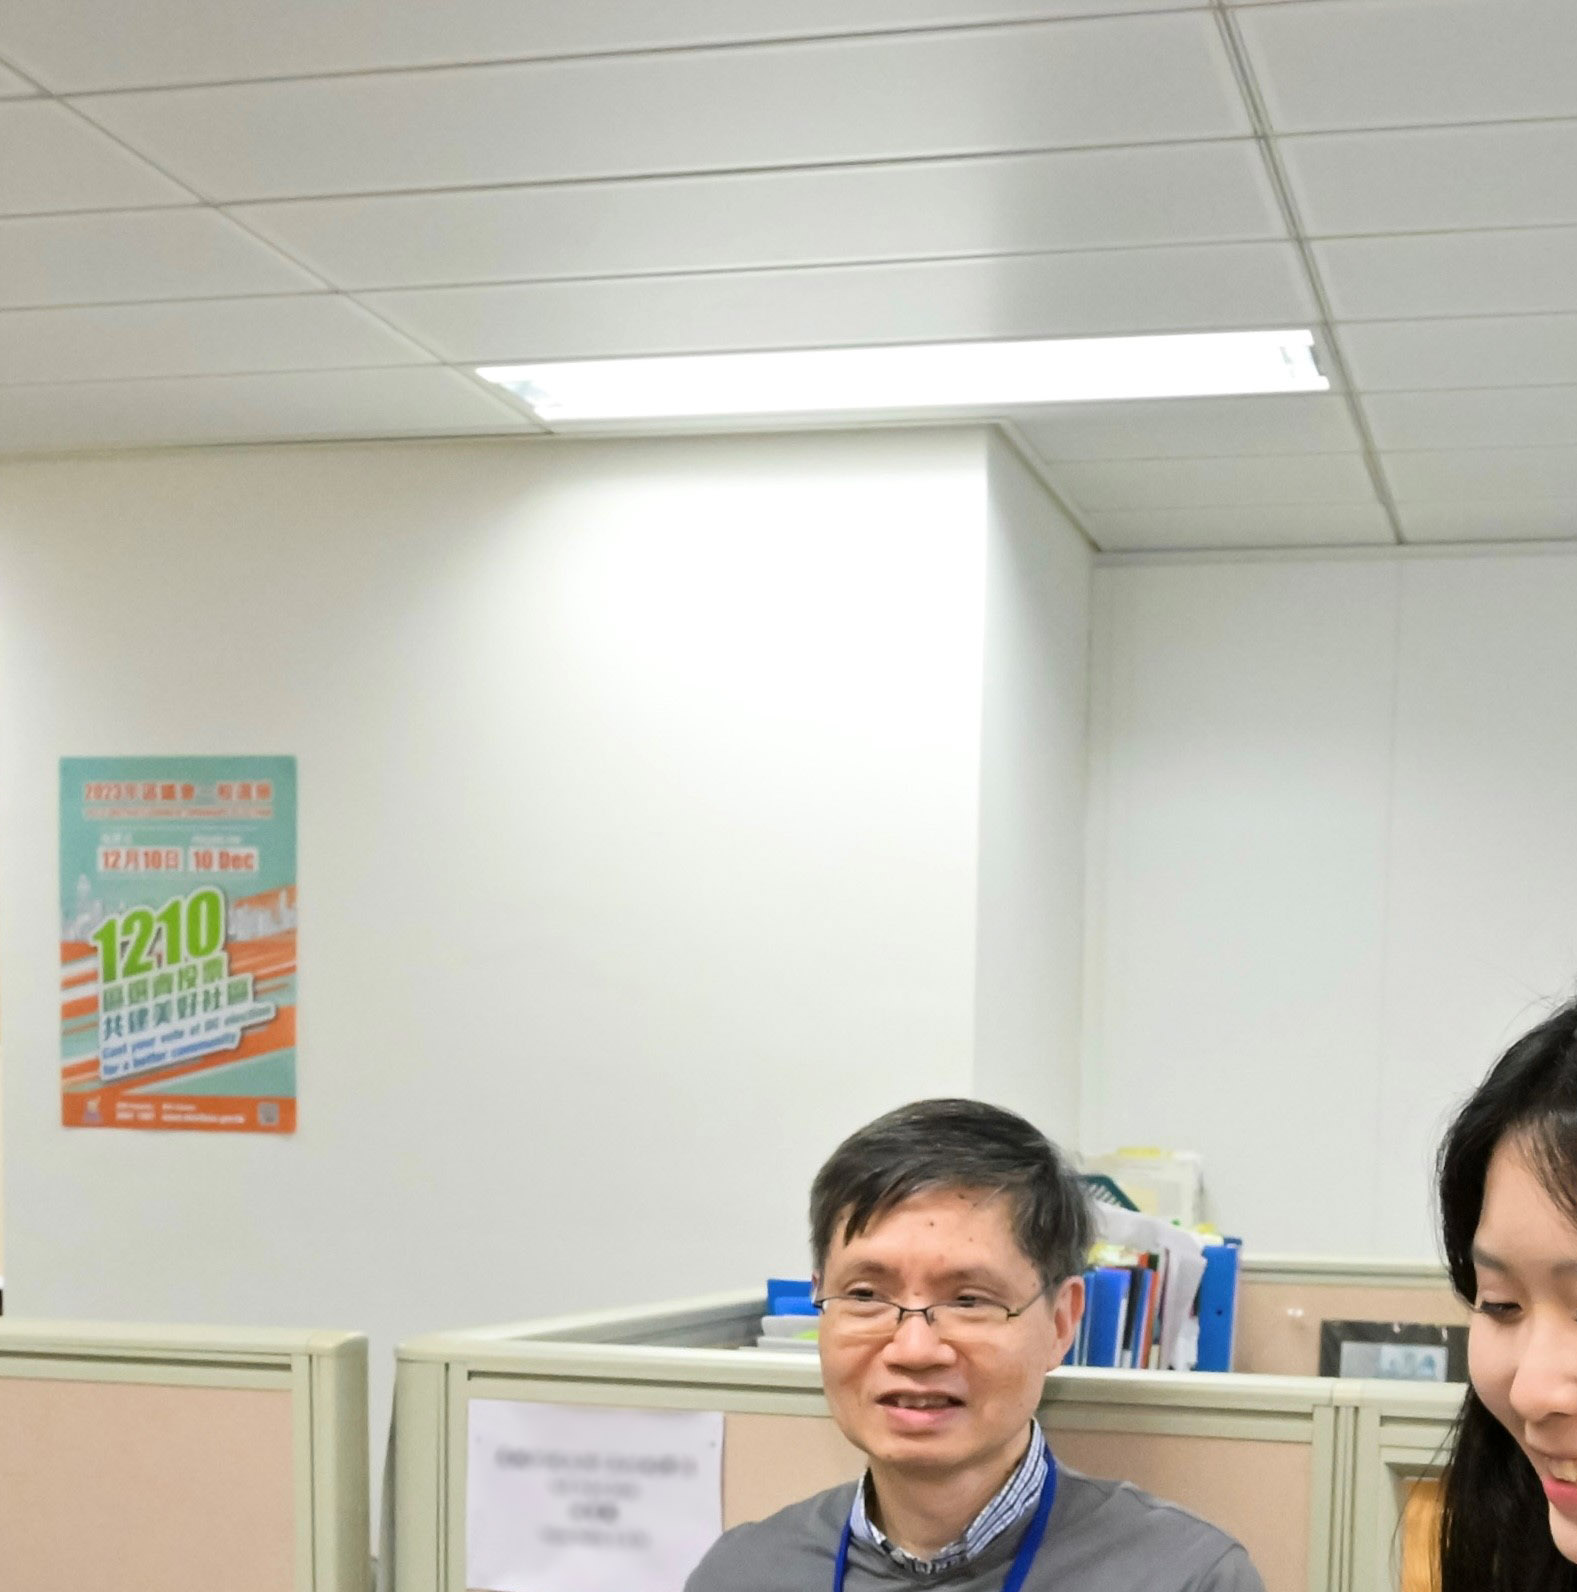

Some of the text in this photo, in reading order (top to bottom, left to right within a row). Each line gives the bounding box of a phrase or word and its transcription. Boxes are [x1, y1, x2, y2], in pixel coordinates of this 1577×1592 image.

[194, 850, 213, 870] 10
[219, 850, 254, 870] Dec
[92, 890, 221, 983] 1210
